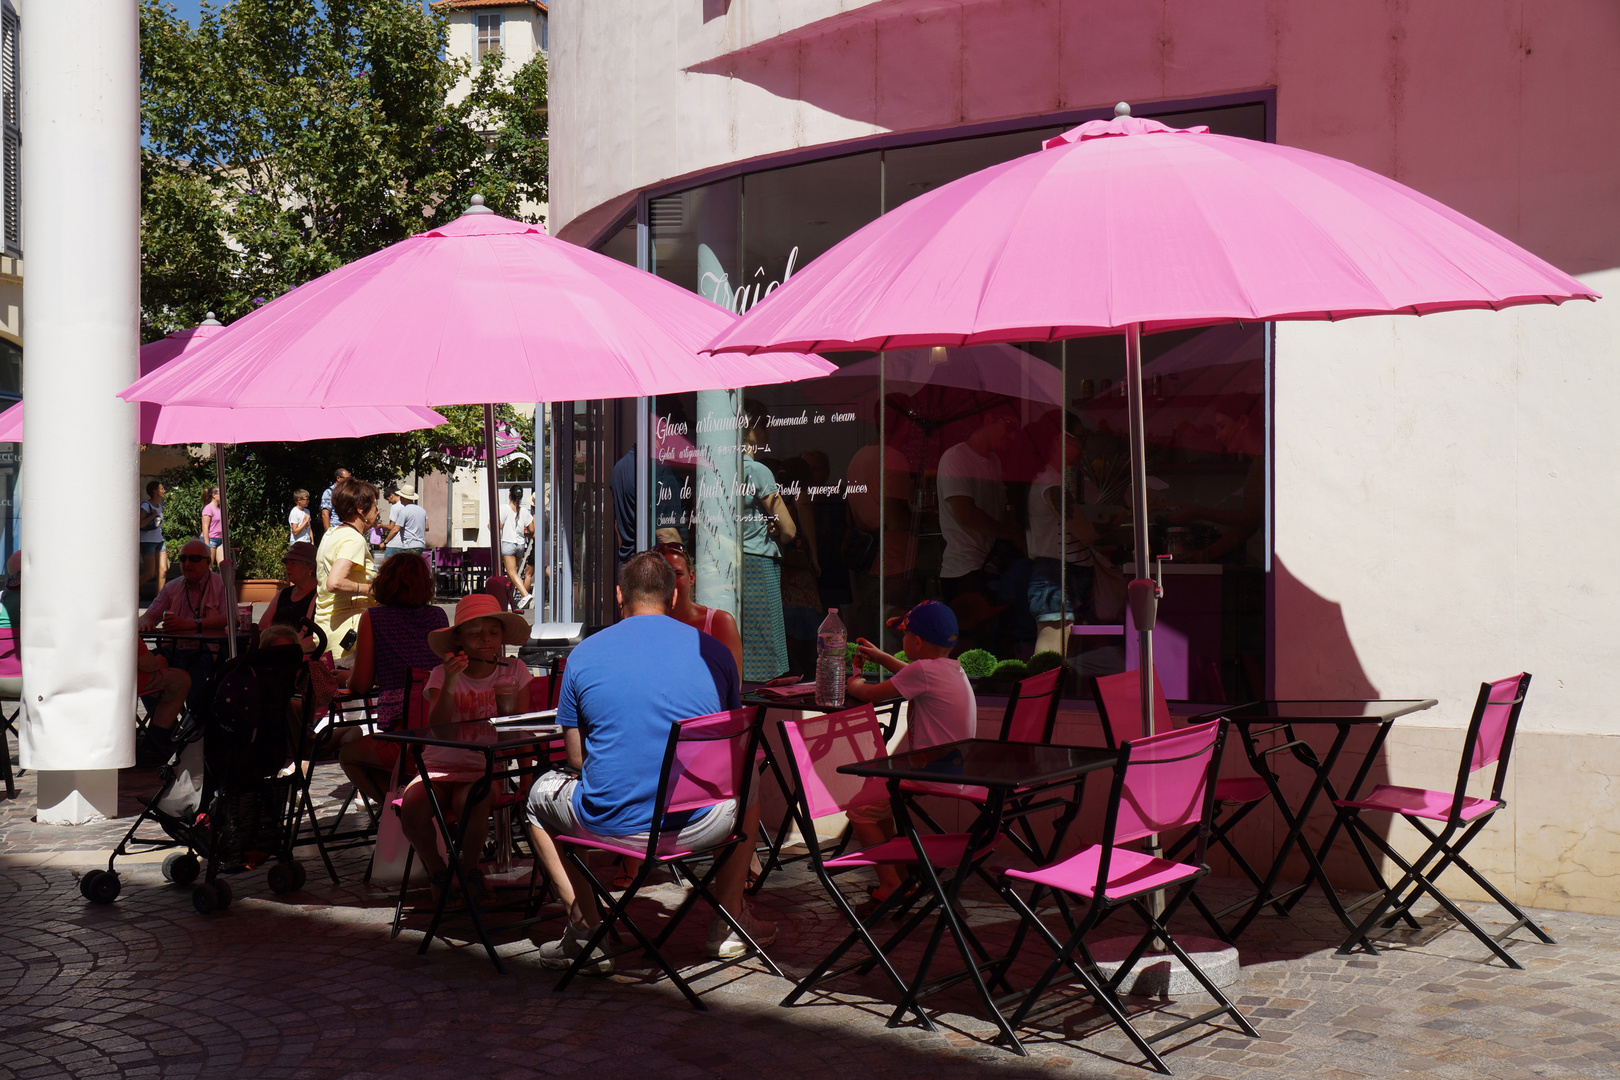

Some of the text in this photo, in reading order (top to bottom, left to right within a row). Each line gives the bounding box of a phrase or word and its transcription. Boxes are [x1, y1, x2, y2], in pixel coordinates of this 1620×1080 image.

[657, 413, 688, 445] Glaces
[696, 404, 749, 434] artisanales
[766, 409, 809, 428] Homemade
[814, 410, 826, 424] ice
[831, 411, 856, 423] cream
[656, 481, 672, 506] Jus
[680, 475, 692, 500] de
[696, 474, 725, 509] fruits
[728, 472, 757, 508] frais
[774, 480, 802, 501] Freshly
[807, 479, 842, 502] squeezed
[842, 480, 868, 500] juices
